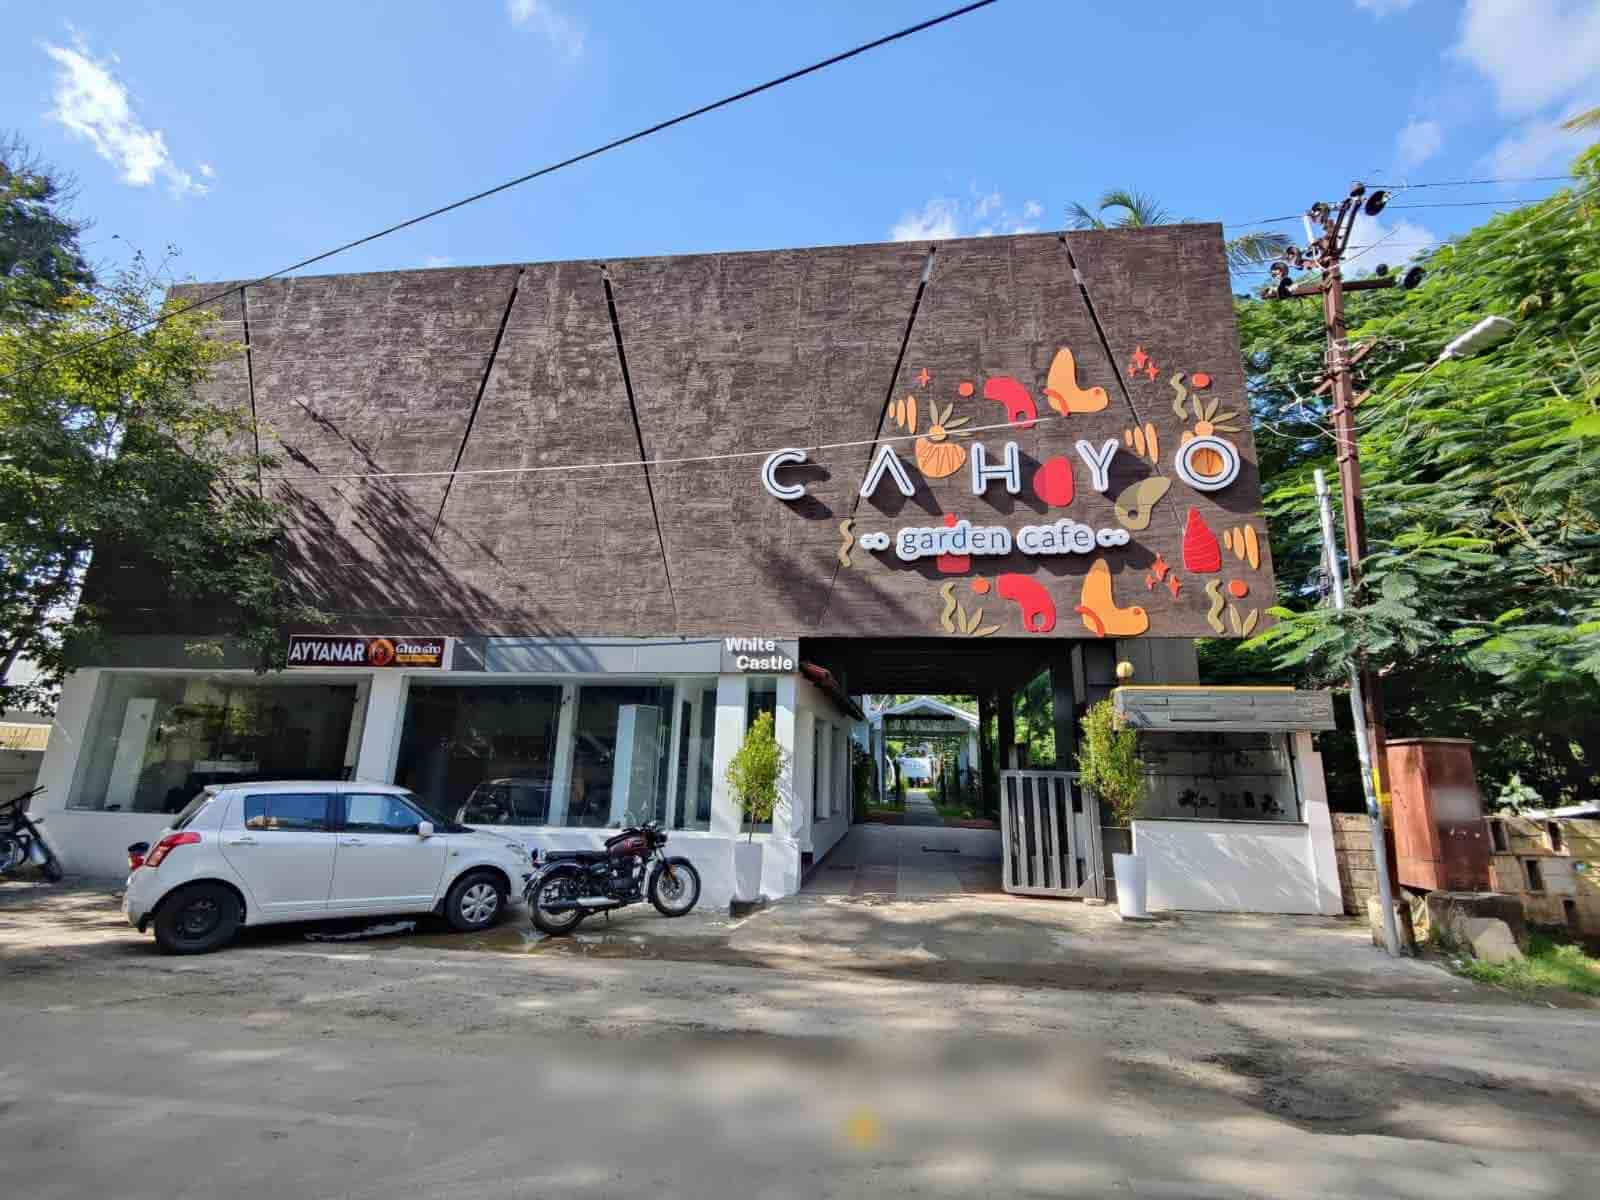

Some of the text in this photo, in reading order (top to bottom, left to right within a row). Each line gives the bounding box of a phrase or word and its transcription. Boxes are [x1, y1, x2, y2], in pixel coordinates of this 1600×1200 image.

[761, 436, 1240, 500] CAHYO
[900, 521, 1093, 556] garden cafe
[290, 642, 363, 662] AYYANAR
[725, 637, 776, 652] White
[736, 655, 793, 670] Castle
